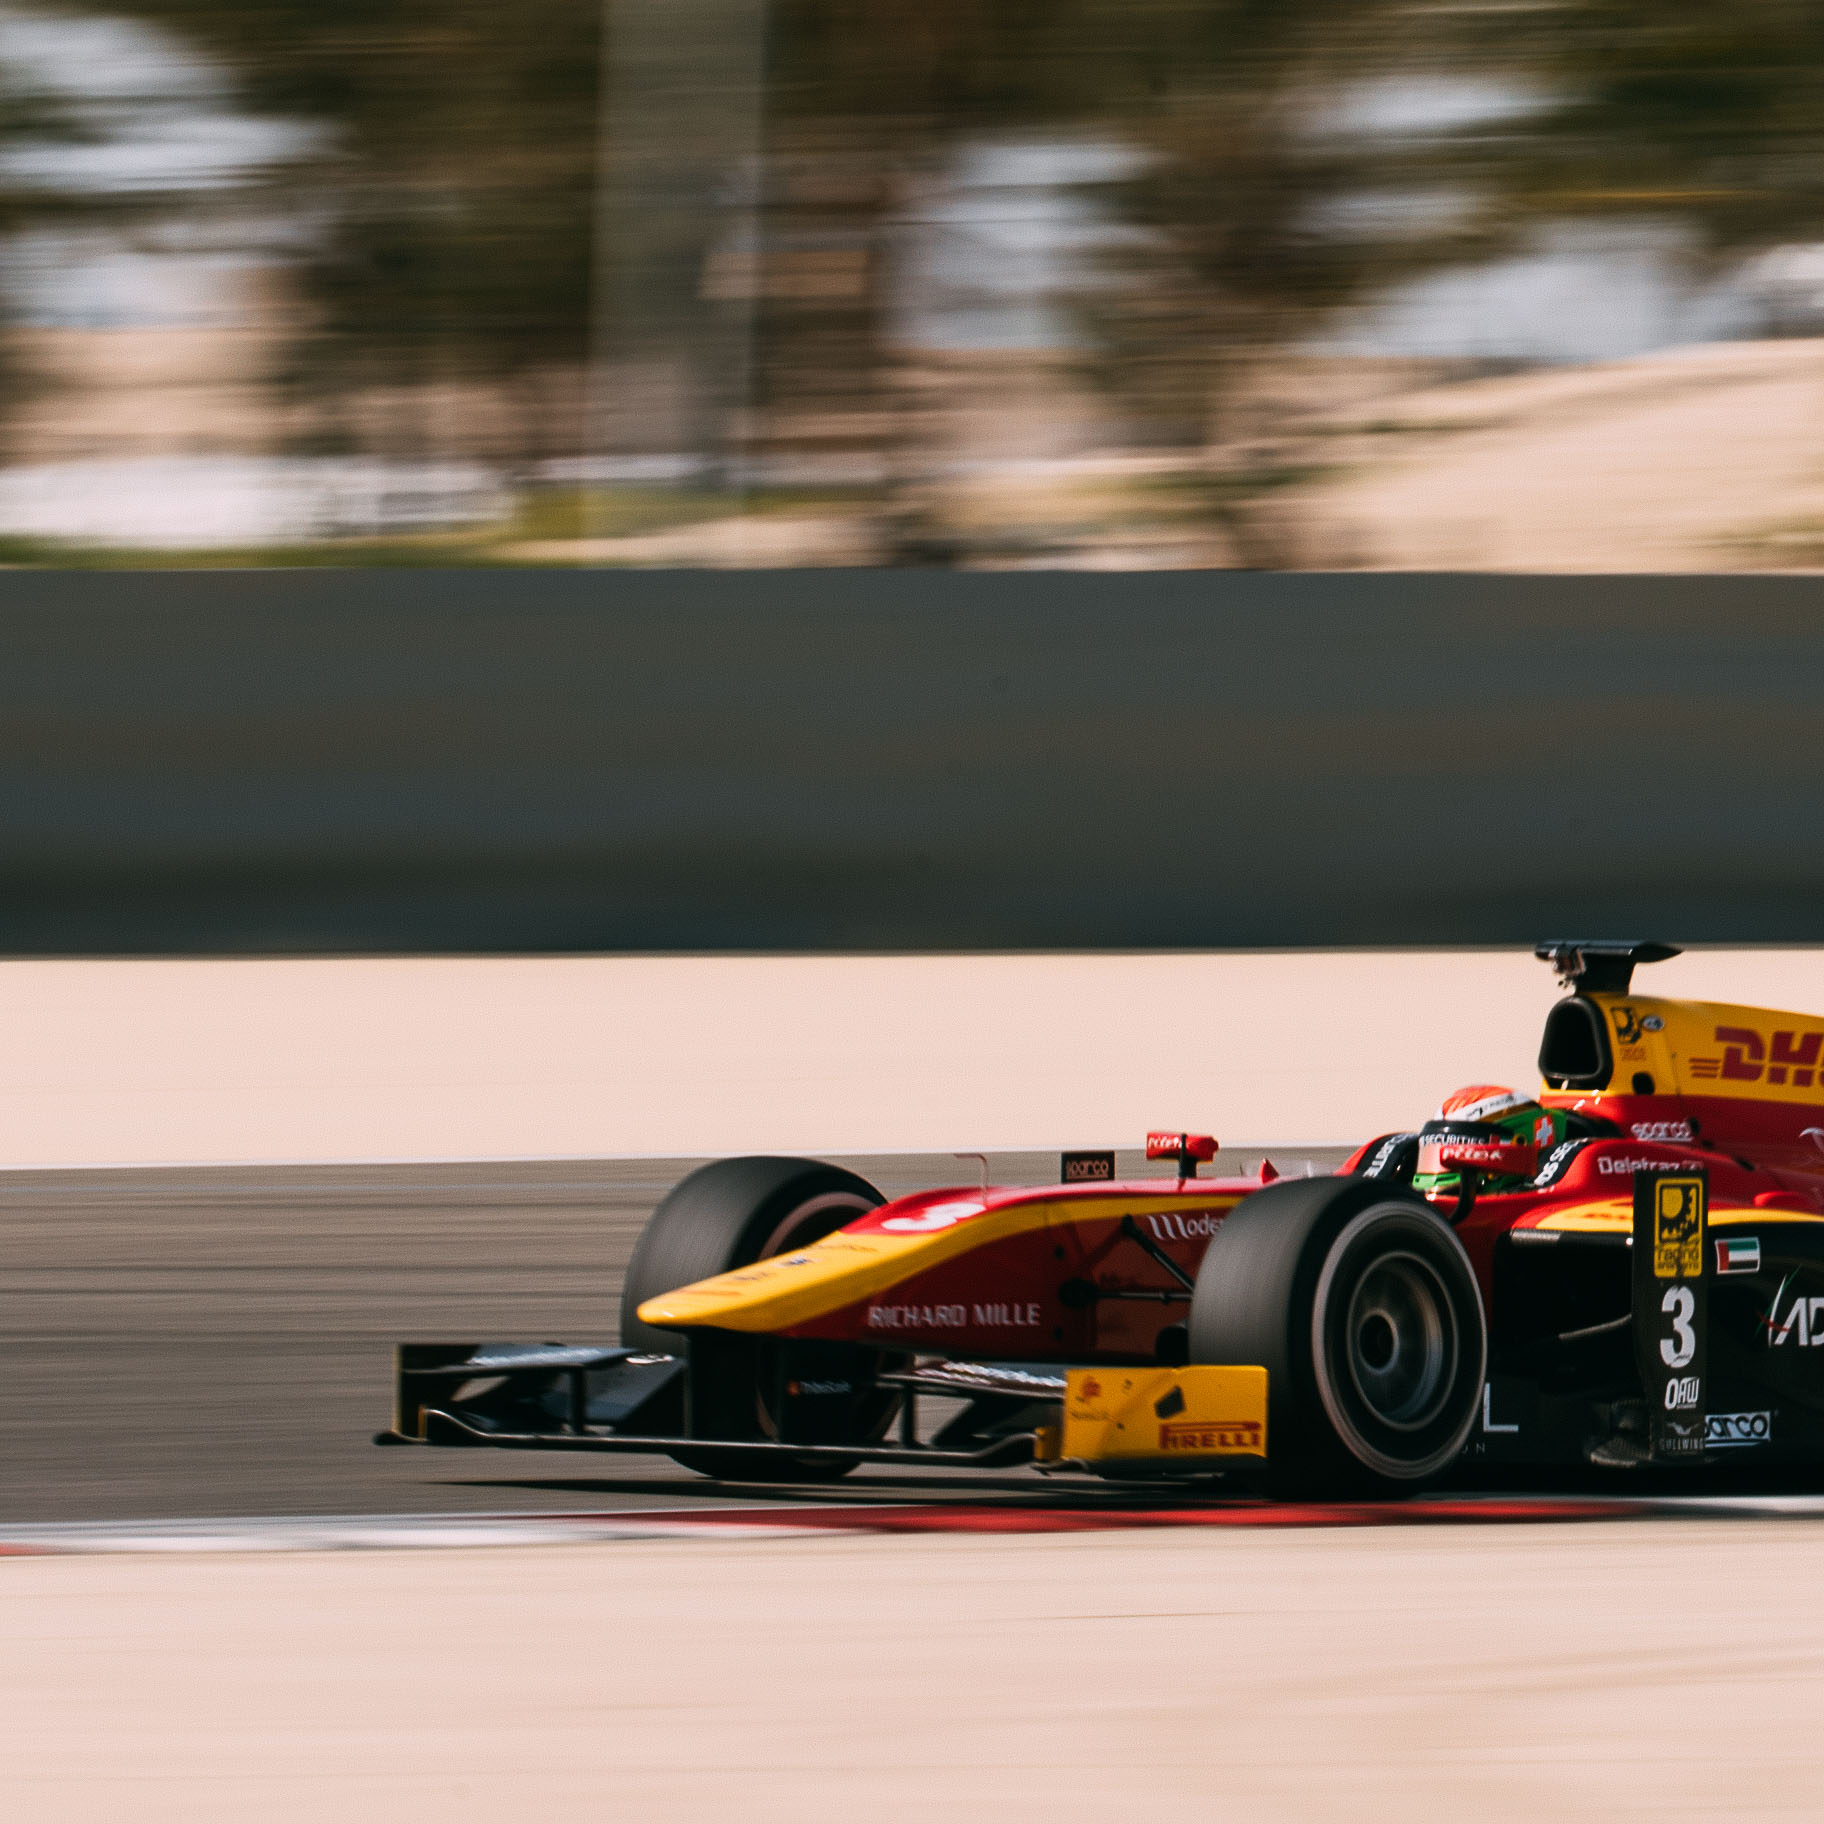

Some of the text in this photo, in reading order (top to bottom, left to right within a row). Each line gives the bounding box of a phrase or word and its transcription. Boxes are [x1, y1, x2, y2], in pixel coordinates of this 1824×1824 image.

[882, 1202, 986, 1231] 3
[1147, 1212, 1224, 1240] Mode
[868, 1303, 1041, 1327] RICHARD MILLE
[1660, 1285, 1696, 1368] 3
[1160, 1422, 1261, 1450] PIRELLI
[1704, 1414, 1768, 1439] arco
